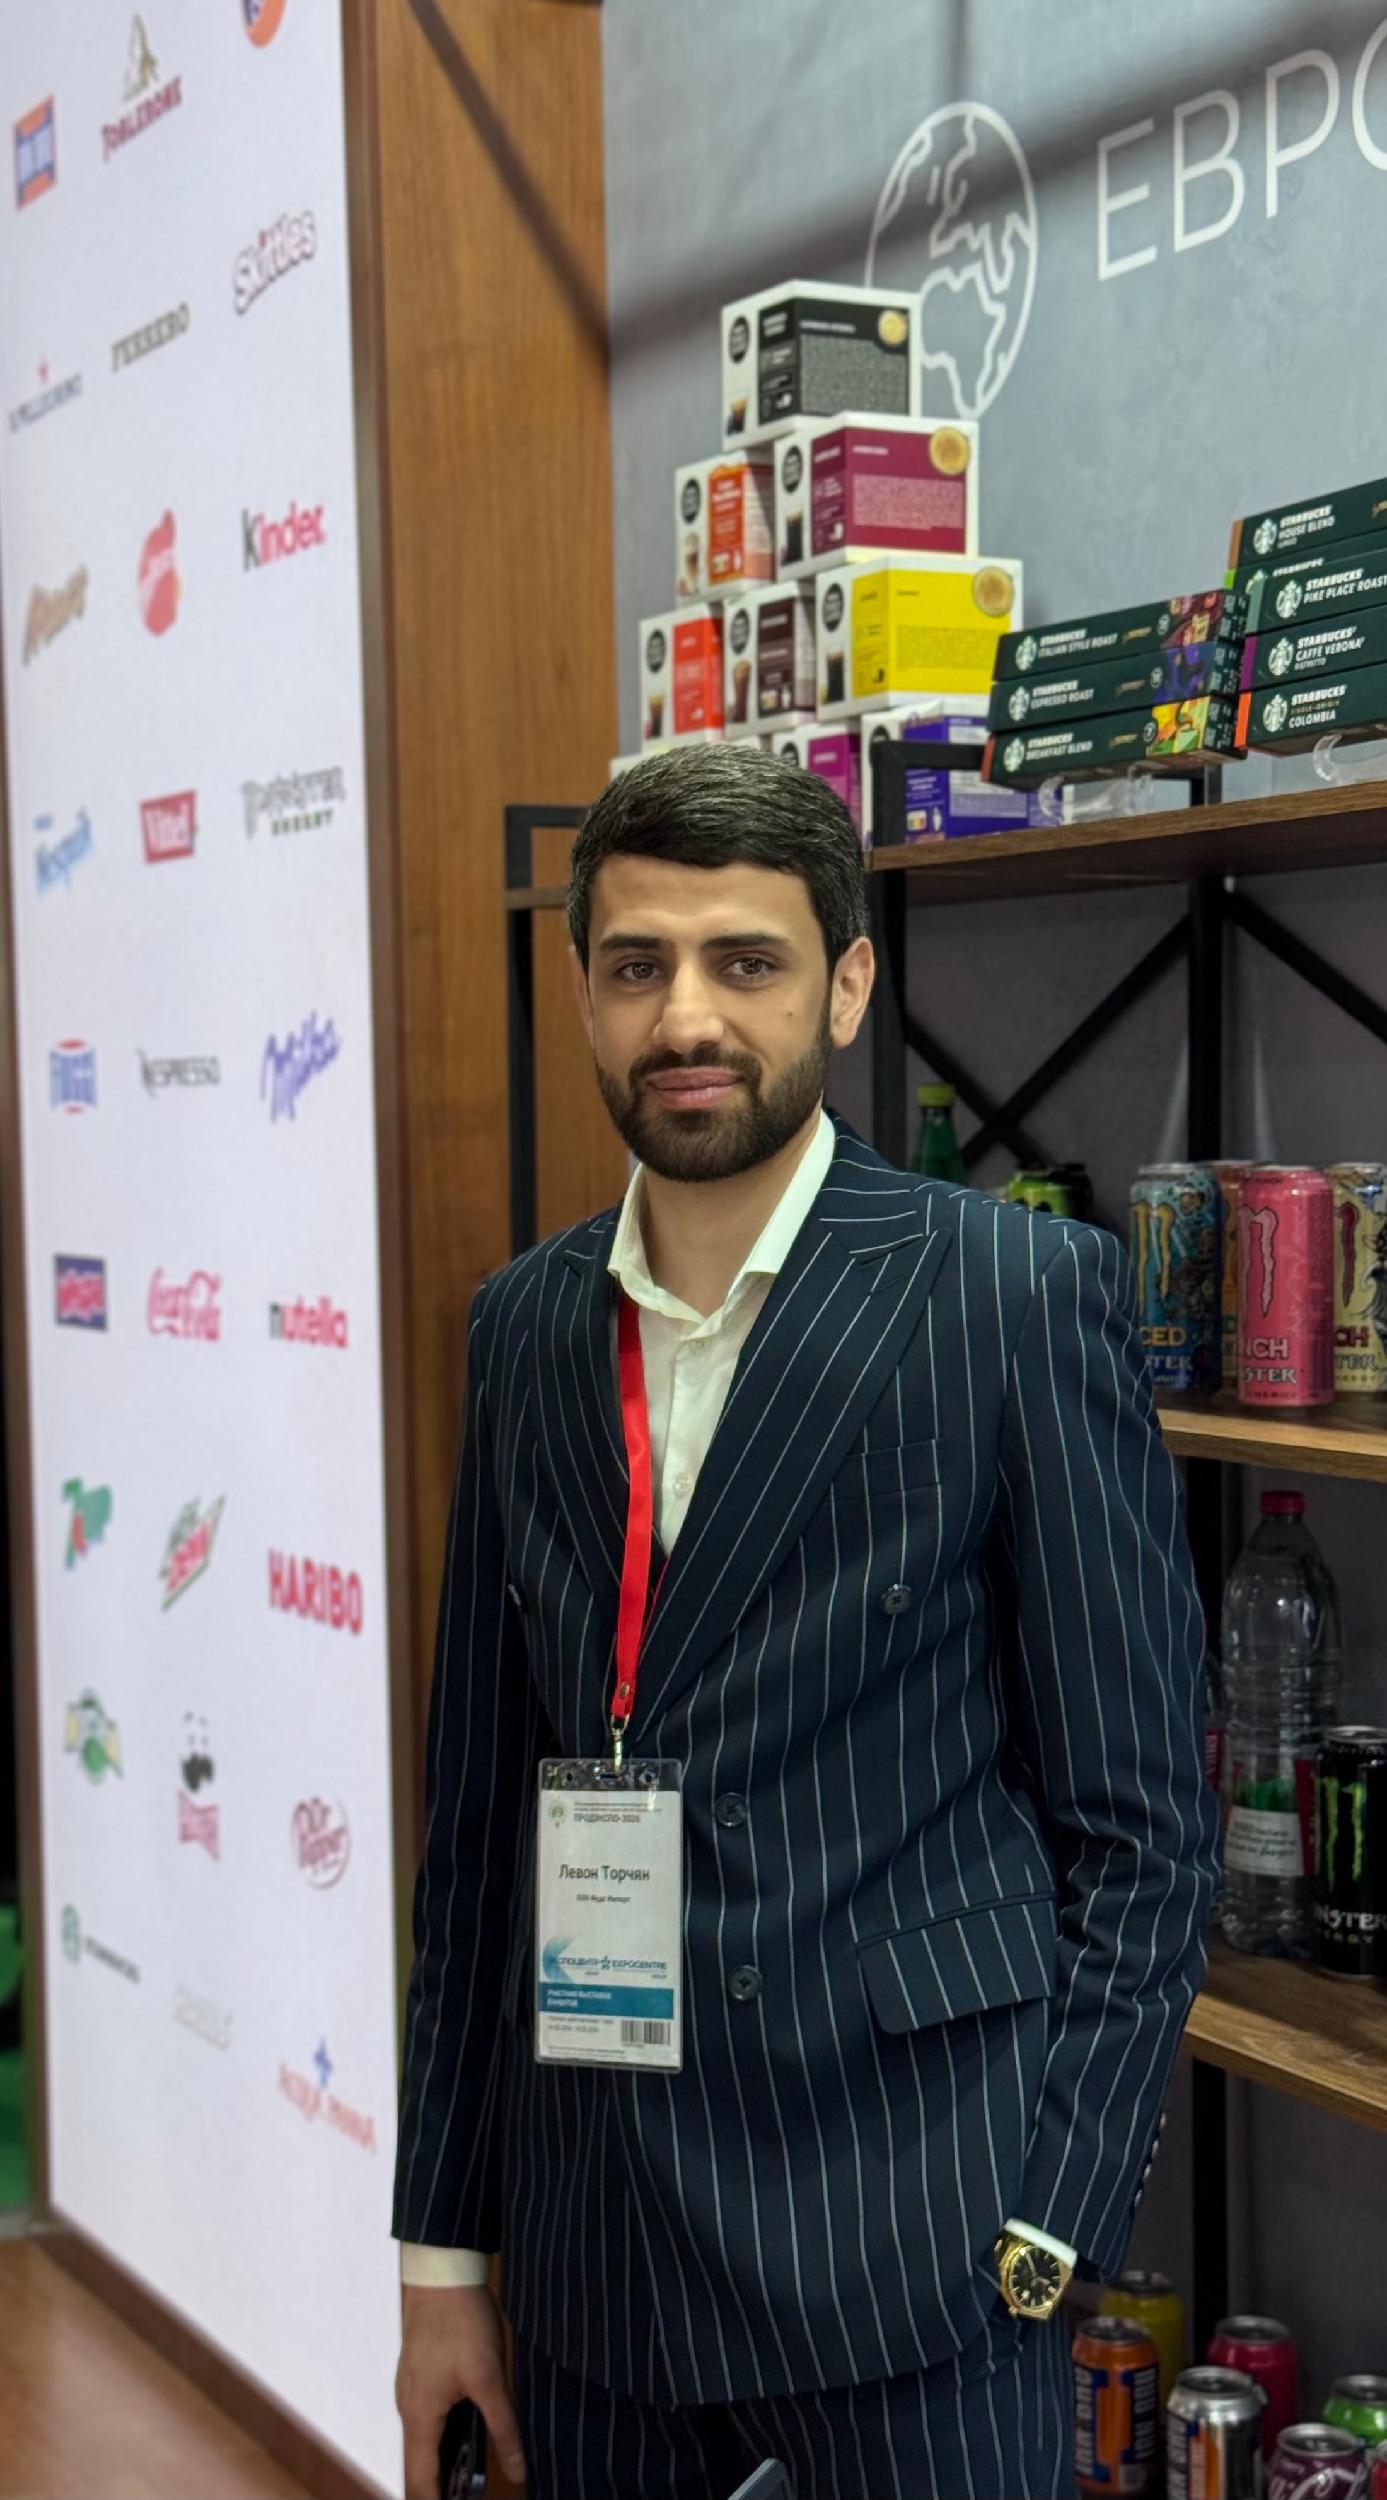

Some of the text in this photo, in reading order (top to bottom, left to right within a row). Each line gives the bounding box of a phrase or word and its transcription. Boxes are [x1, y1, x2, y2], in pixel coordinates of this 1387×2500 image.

[1279, 515, 1335, 539] HOUSE BLEND
[1280, 504, 1333, 528] STARBUCKS
[1304, 574, 1387, 604] PIKE PLACE ROAST
[1305, 567, 1364, 592] STARBUCKS
[1040, 628, 1087, 647] STARBUCKS
[1068, 638, 1090, 653] STYLE
[1091, 633, 1118, 648] ROAST
[1297, 626, 1357, 650] STARBUCKS
[1030, 688, 1094, 710] ESPRESSO ROAST
[1032, 680, 1079, 698] STARBUCKS
[1291, 684, 1347, 706] STARBUCKS
[1289, 710, 1336, 728] COLOMBIA
[1026, 744, 1067, 760] BREAKFAST
[1067, 740, 1093, 754] BLEND
[1027, 732, 1074, 750] STARBUCKS
[269, 1295, 347, 1349] nutella
[1139, 1326, 1187, 1348] CED
[268, 1547, 364, 1636] HARIBO
[559, 1864, 650, 1885] Левон Торчян
